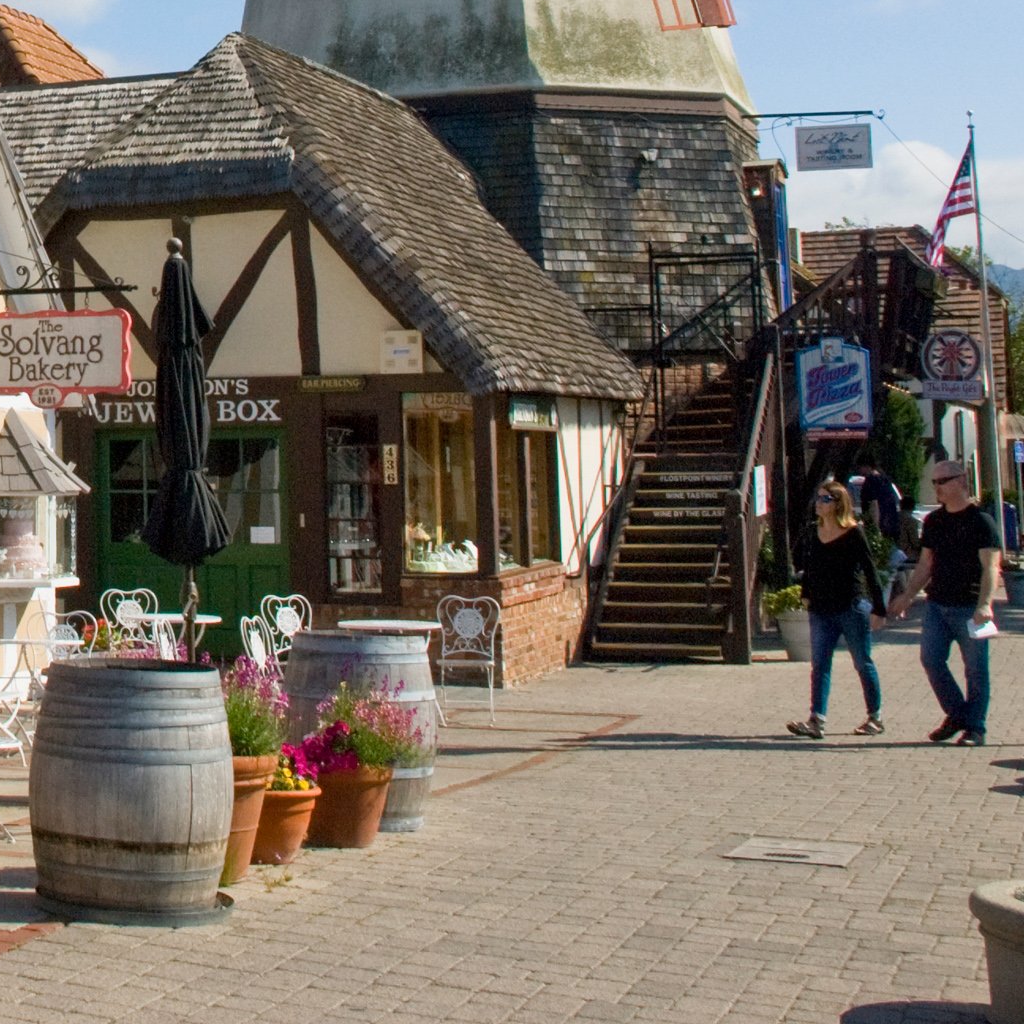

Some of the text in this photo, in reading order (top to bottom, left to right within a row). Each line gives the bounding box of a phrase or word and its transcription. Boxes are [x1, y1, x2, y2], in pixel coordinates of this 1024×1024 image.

[39, 320, 63, 333] The
[9, 357, 89, 386] Bakery
[38, 388, 56, 396] EST
[127, 378, 249, 397] JOON'S
[97, 399, 281, 423] JEW BOX
[384, 447, 397, 483] 436
